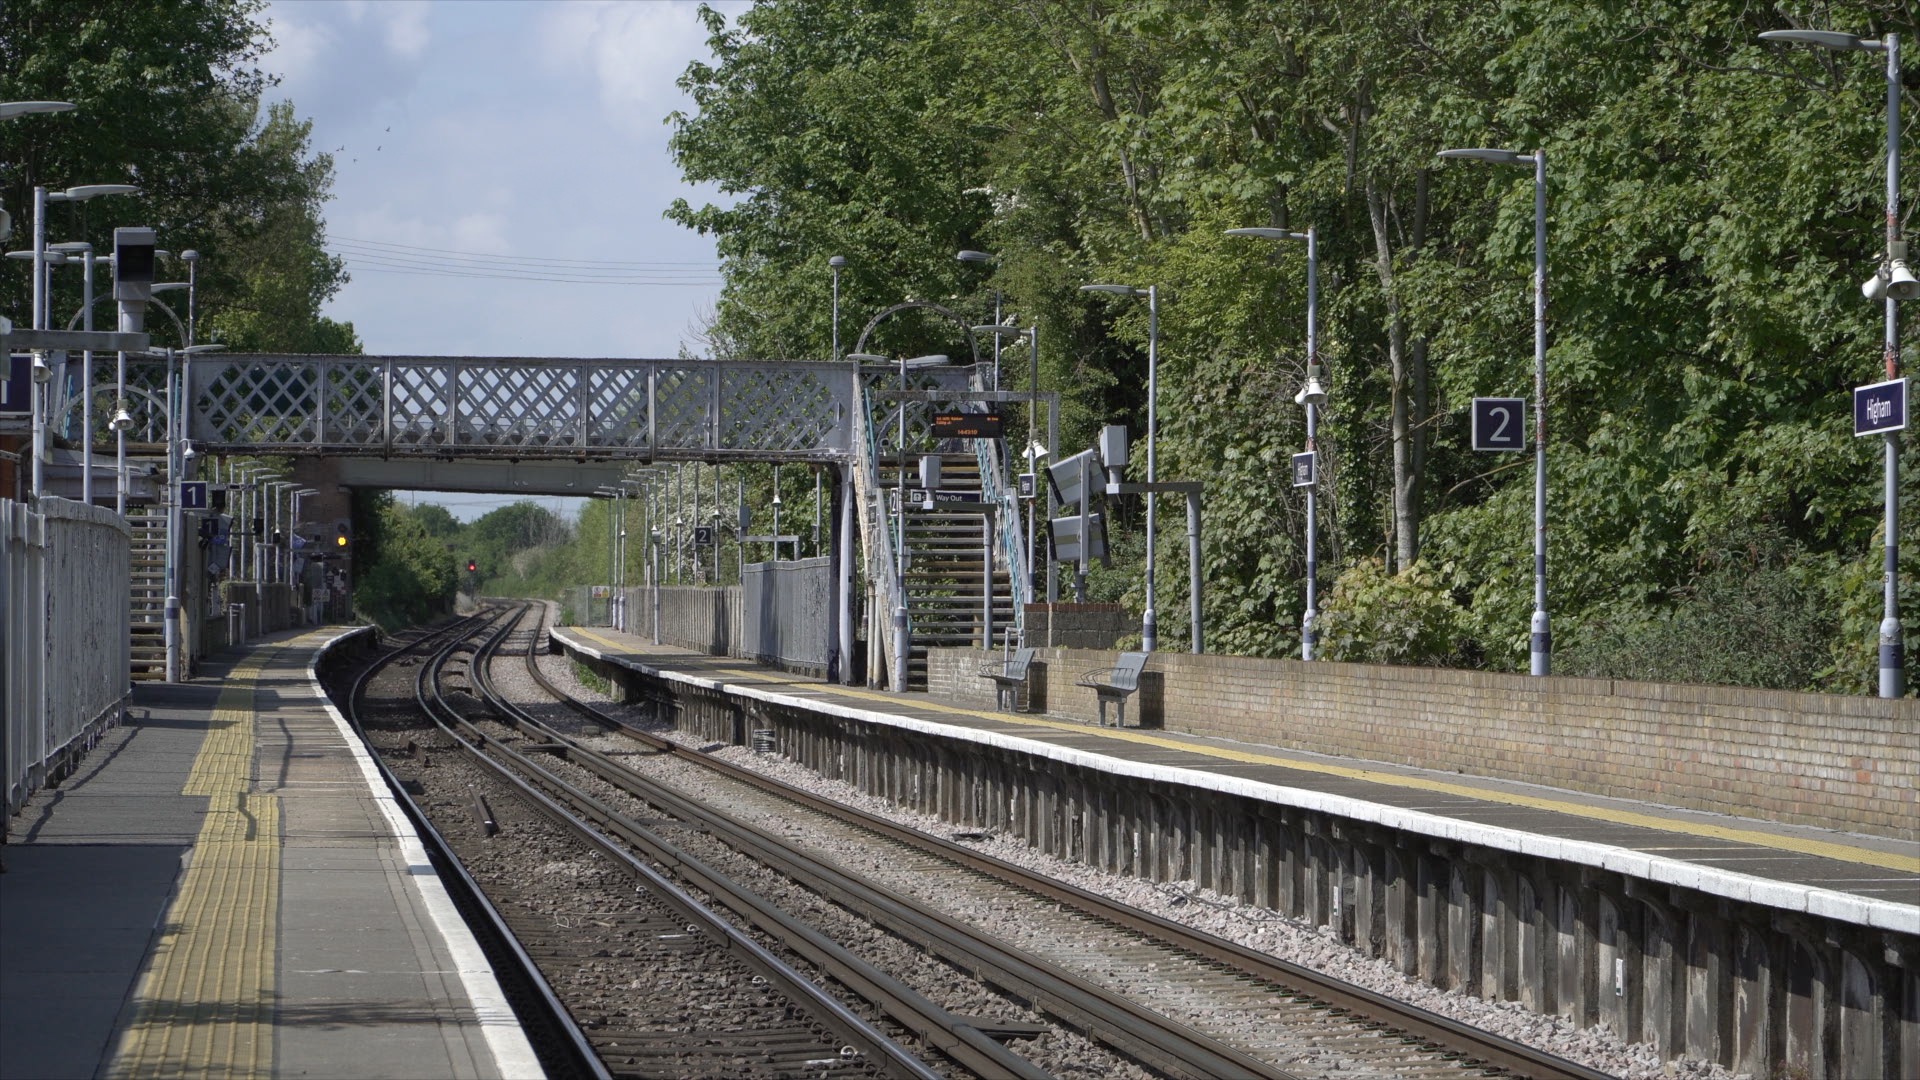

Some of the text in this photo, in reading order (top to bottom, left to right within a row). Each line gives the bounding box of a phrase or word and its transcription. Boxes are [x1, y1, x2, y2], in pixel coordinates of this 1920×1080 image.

[1867, 397, 1891, 425] Higham
[1489, 407, 1511, 442] 2
[187, 486, 196, 506] 1
[935, 494, 962, 502] Way Out
[206, 520, 212, 534] 1
[698, 529, 707, 542] 2
